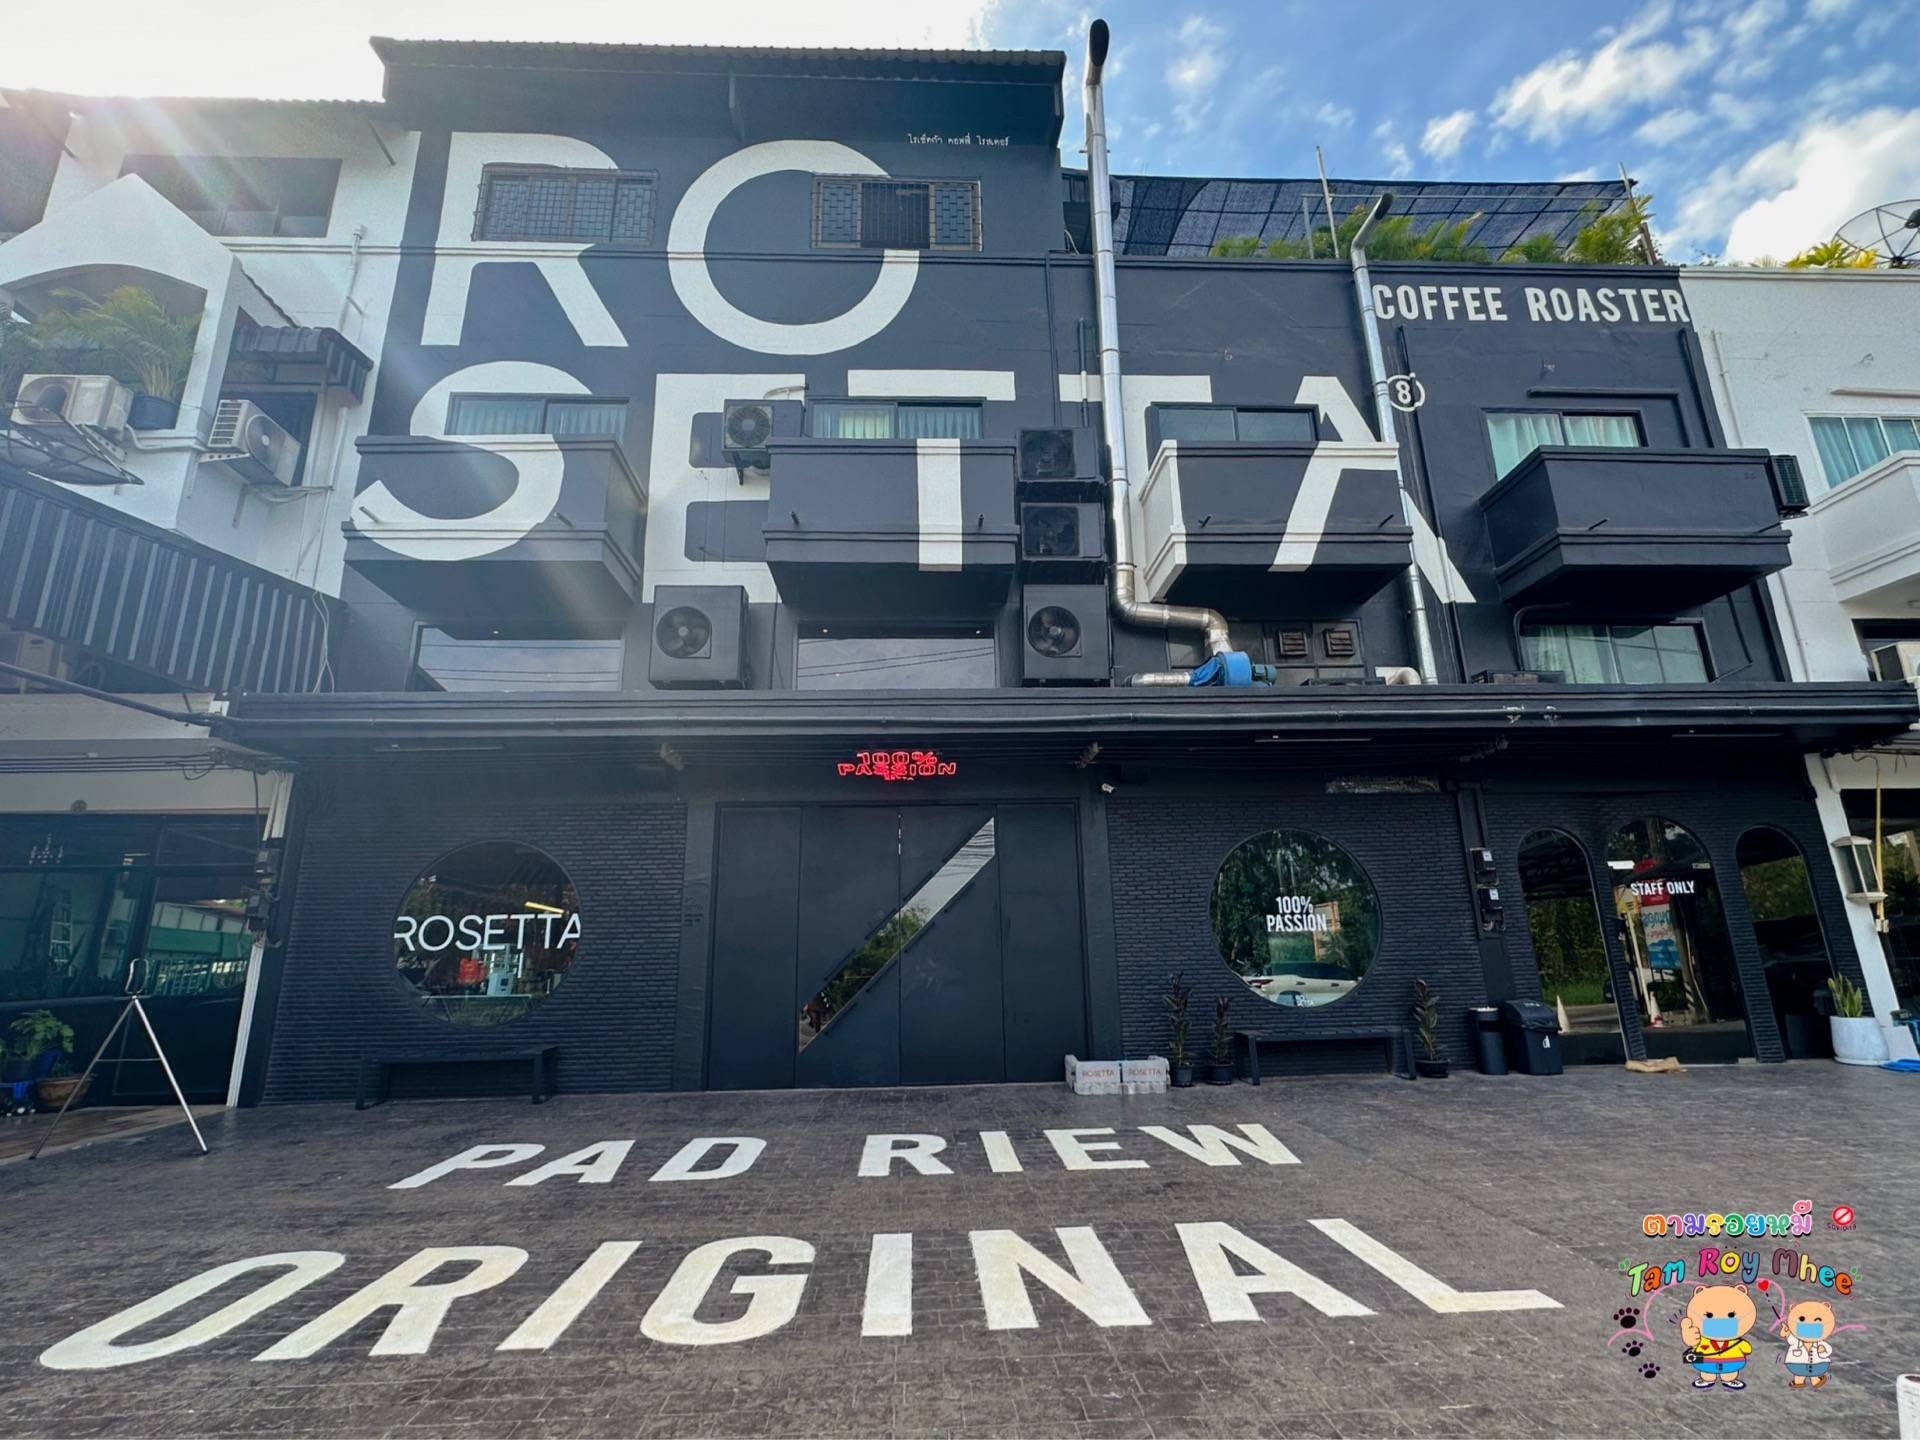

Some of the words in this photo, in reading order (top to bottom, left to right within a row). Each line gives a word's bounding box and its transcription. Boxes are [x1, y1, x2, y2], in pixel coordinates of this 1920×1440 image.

[421, 131, 920, 356] RO
[1372, 285, 1508, 321] COFFEE
[1524, 287, 1690, 323] ROASTER
[350, 360, 1477, 605] SETTA
[837, 763, 957, 776] PASSION
[856, 751, 938, 765] 100%
[1275, 895, 1314, 914] 100%
[1630, 880, 1665, 896] STAFF
[1667, 879, 1696, 895] ONLY
[393, 912, 582, 952] ROSETTA
[1266, 913, 1328, 933] PASSION
[386, 1136, 769, 1190] PAD
[856, 1123, 1303, 1178] RIEW
[38, 1217, 1572, 1371] ORIGINAL
